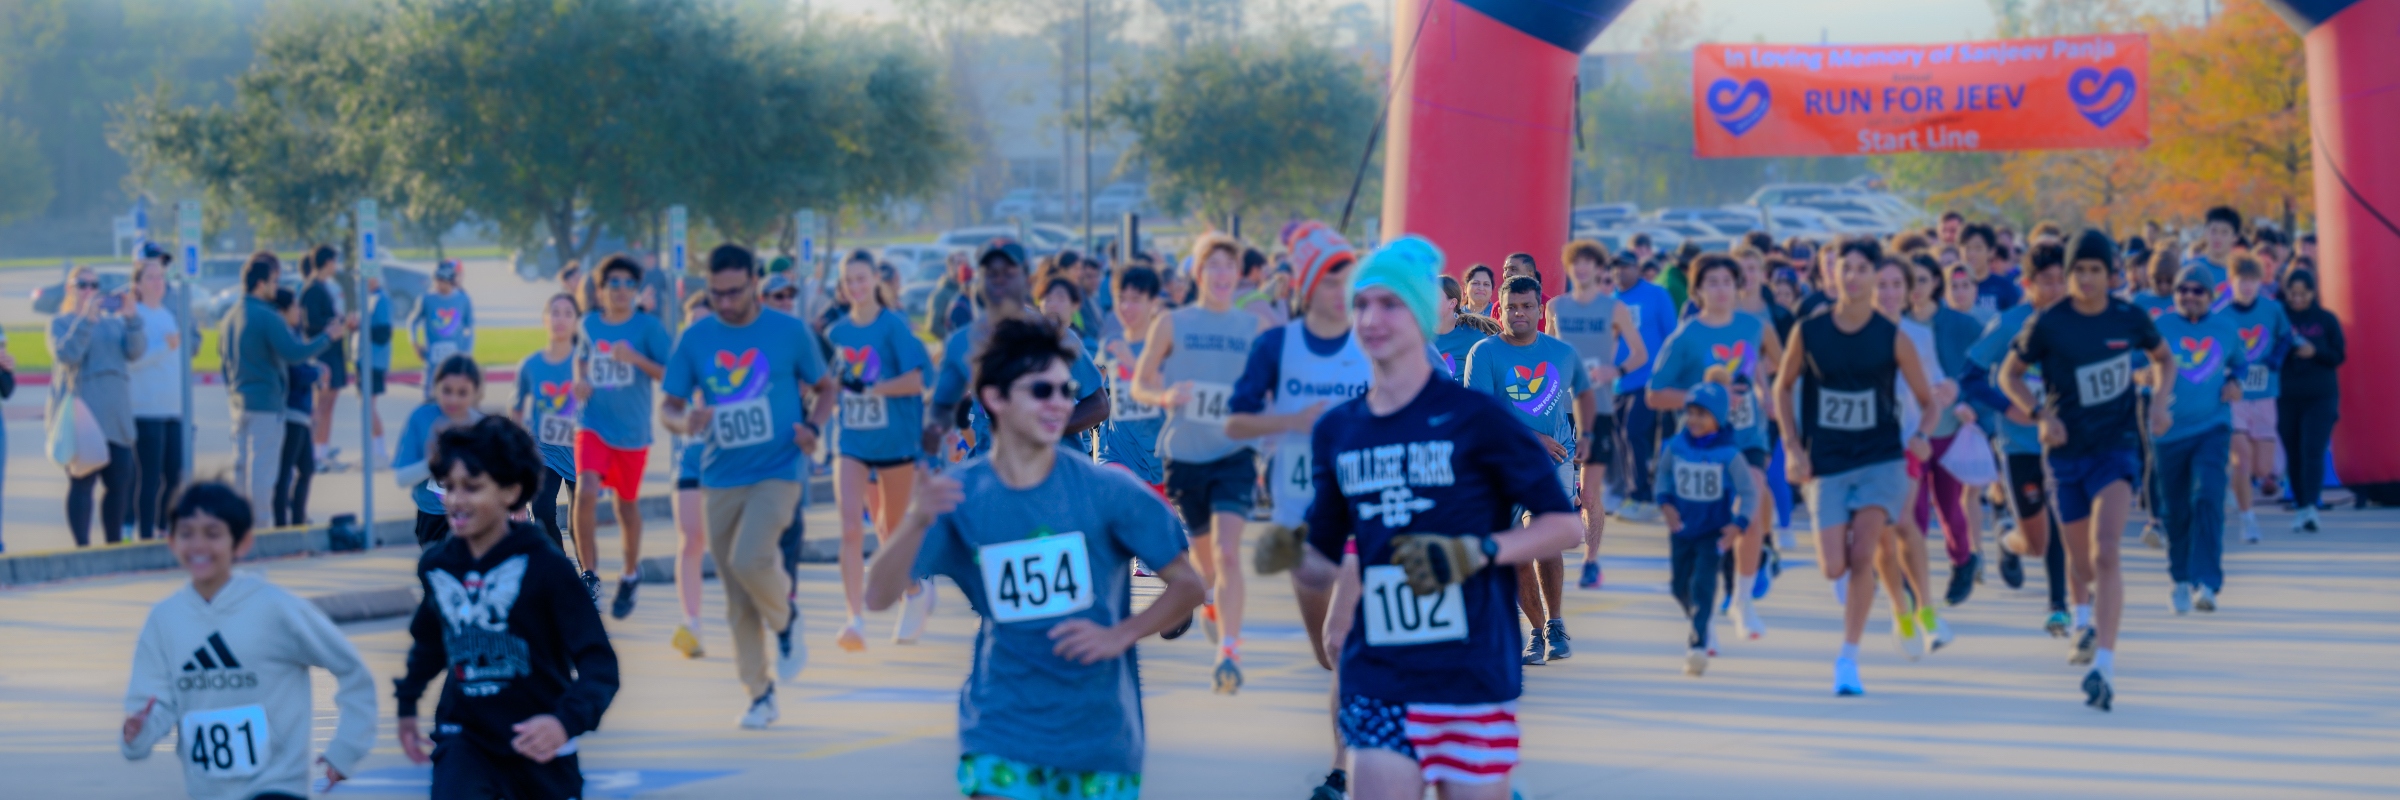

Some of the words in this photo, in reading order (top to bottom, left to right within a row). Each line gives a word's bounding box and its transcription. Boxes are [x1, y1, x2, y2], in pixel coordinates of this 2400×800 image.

[1724, 48, 1746, 68] In
[1751, 47, 1823, 72] Loving
[1828, 48, 1924, 68] Memory
[1929, 44, 1954, 64] of
[1957, 43, 2048, 66] Sanjeev
[1804, 88, 1872, 116] RUN
[1883, 86, 1944, 114] FOR
[1954, 83, 2026, 112] JEEV
[1857, 128, 1918, 153] Start
[1925, 126, 1980, 150] Line
[1286, 378, 1369, 397] Onward
[1532, 402, 1544, 414] RUN
[1542, 392, 1552, 405] FOR
[1551, 379, 1559, 395] JEEV
[2088, 361, 2127, 399] 197
[1195, 391, 1230, 419] 14
[1825, 396, 1868, 424] 271
[719, 405, 768, 443] 509
[1408, 440, 1455, 486] PARK
[1678, 466, 1719, 498] 218
[1000, 551, 1078, 609] 454
[1374, 581, 1450, 633] 102
[178, 671, 258, 691] adidas
[191, 719, 257, 771] 481
